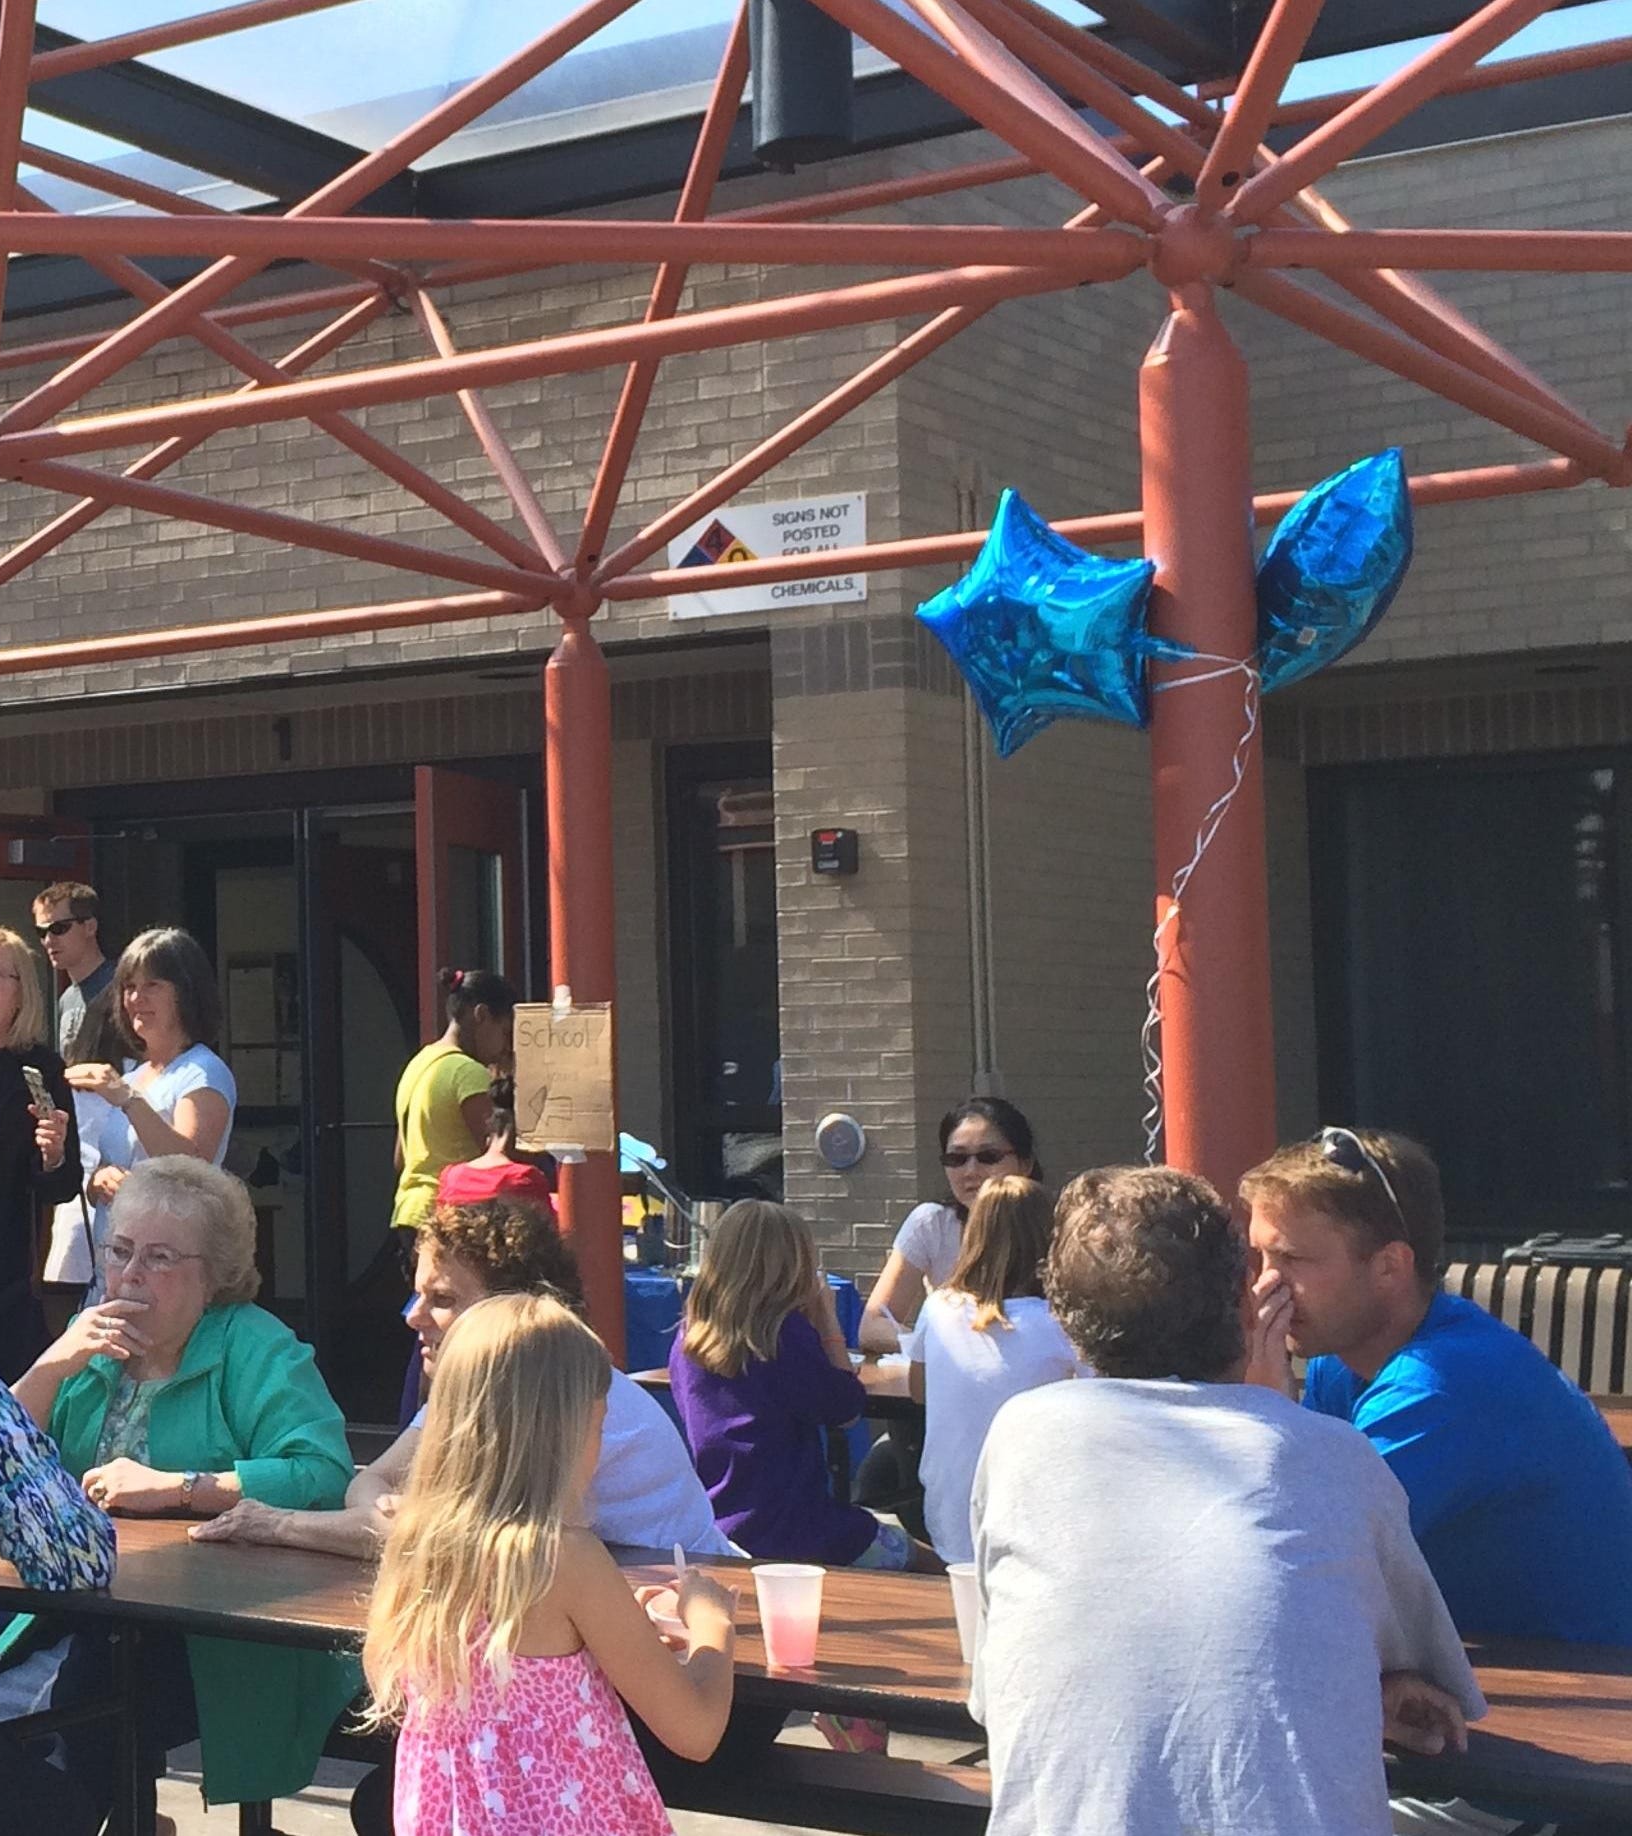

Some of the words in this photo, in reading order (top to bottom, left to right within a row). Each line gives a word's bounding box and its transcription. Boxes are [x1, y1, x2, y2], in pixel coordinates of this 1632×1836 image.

[772, 509, 816, 527] SIGNS
[819, 503, 850, 520] NOT
[783, 524, 841, 543] POSTED
[518, 1017, 590, 1049] School
